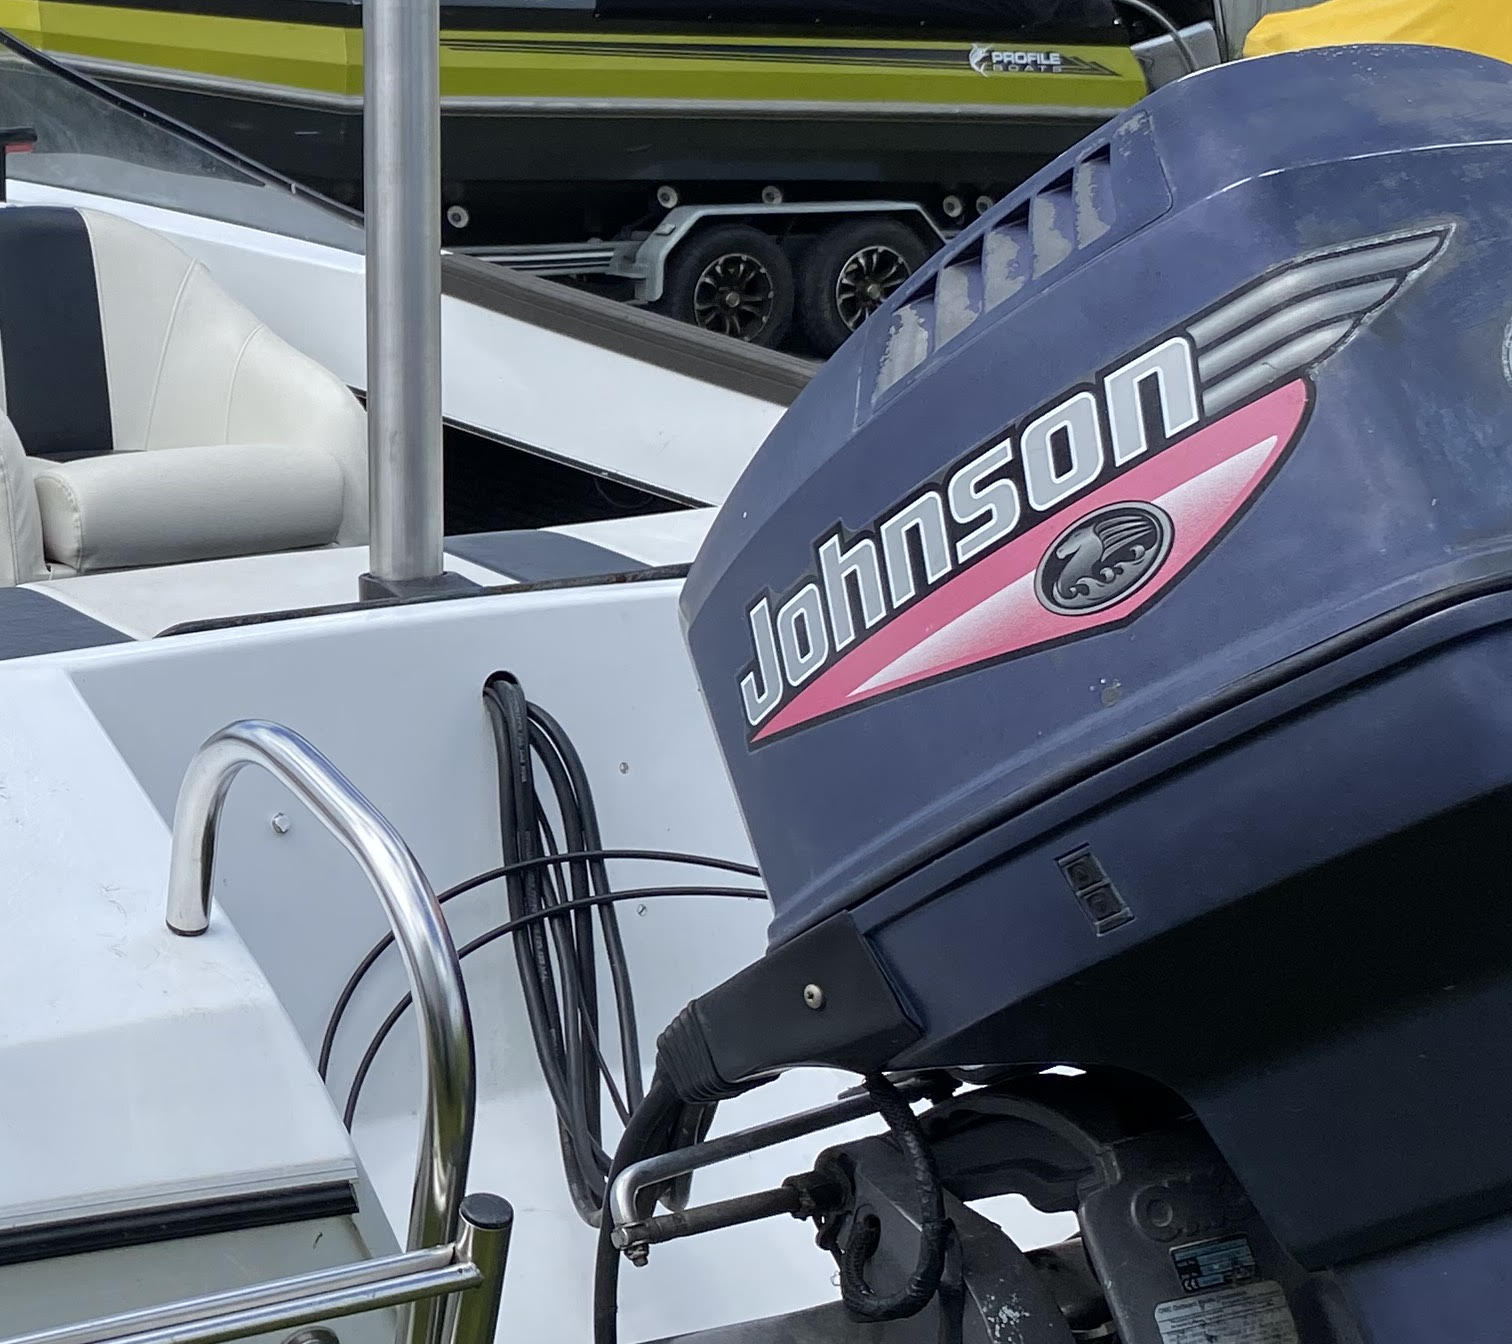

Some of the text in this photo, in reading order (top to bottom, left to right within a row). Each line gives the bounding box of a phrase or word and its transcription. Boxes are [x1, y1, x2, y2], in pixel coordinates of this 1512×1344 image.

[991, 51, 1061, 65] PROFILE
[992, 64, 1062, 73] BOATS
[740, 336, 1200, 726] Johnson
